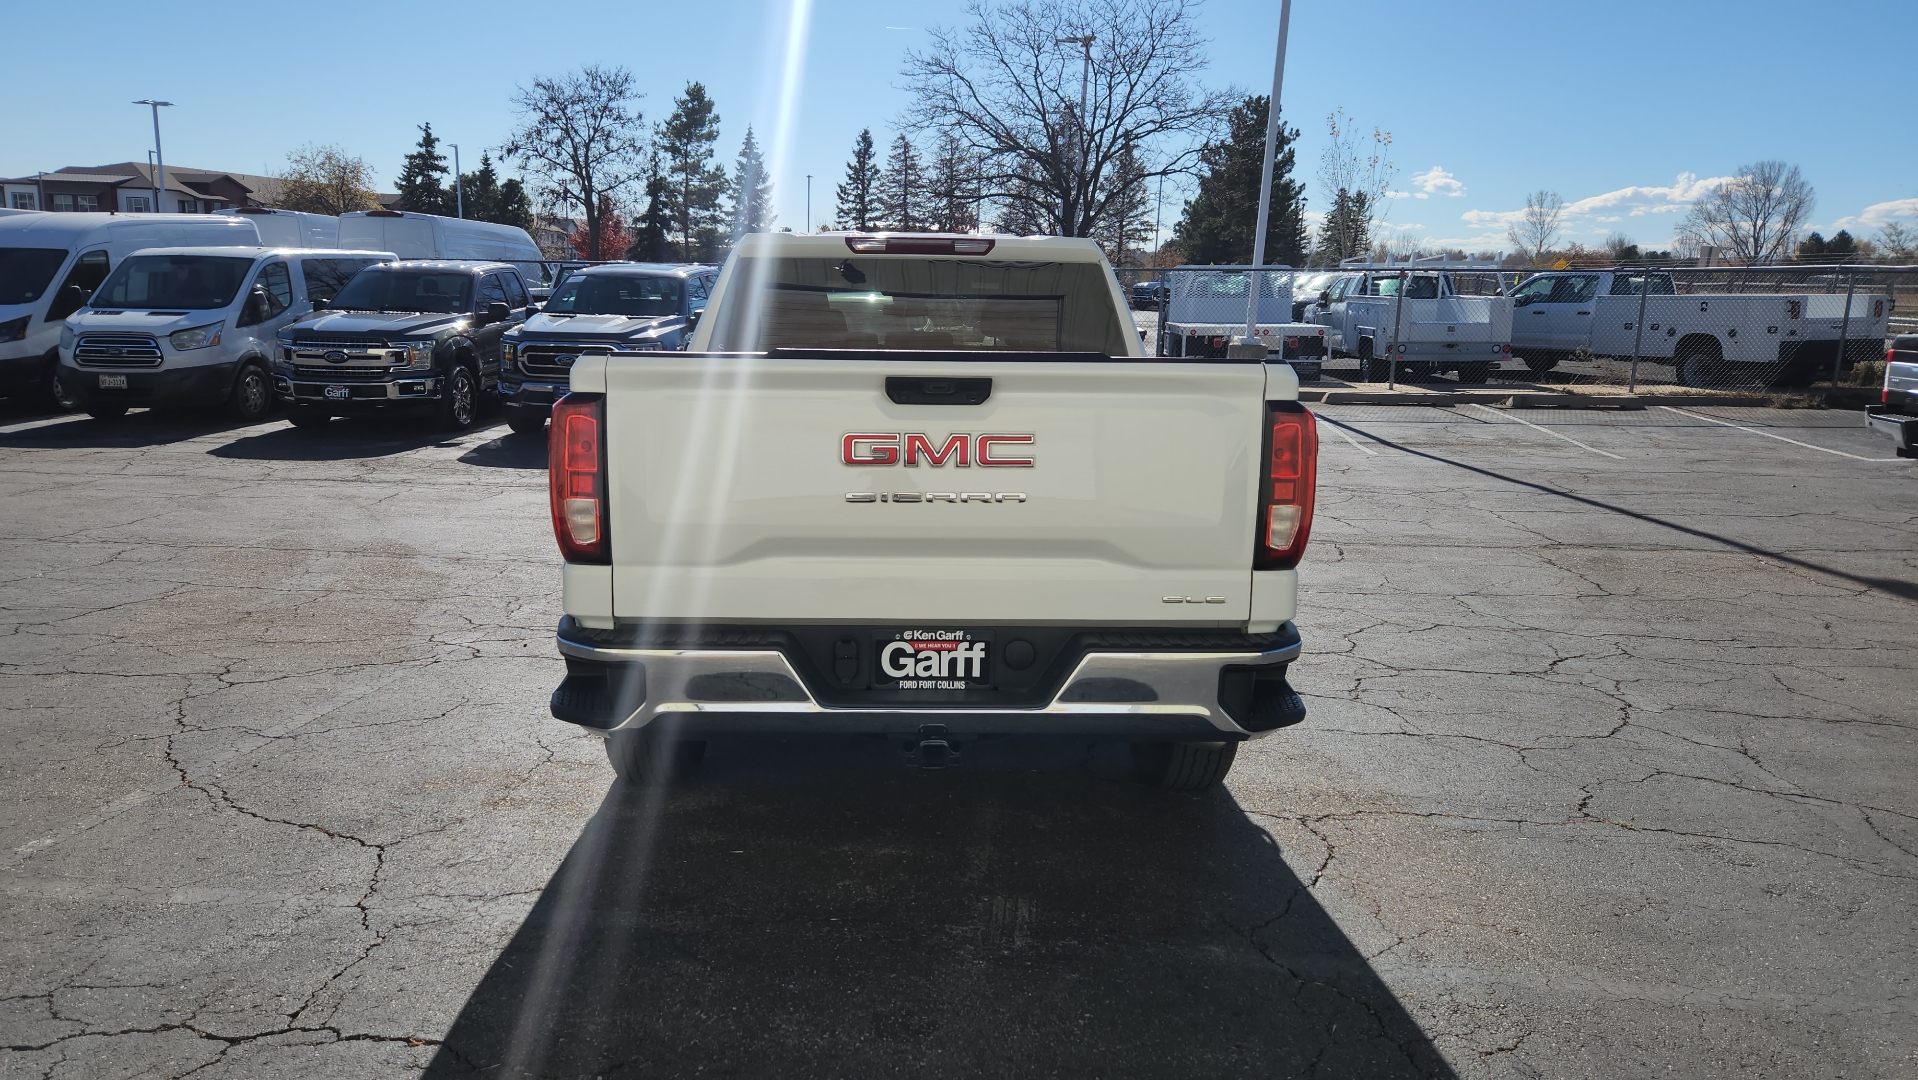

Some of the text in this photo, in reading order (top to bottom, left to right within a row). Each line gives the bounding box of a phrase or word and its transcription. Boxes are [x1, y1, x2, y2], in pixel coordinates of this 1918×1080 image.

[325, 387, 350, 398] Garff
[841, 432, 1035, 468] GMC
[845, 491, 1028, 503] SIERRA
[913, 630, 964, 641] Ken Garff
[881, 641, 986, 678] Garff
[899, 680, 965, 689] FORD FORT COLLINS
